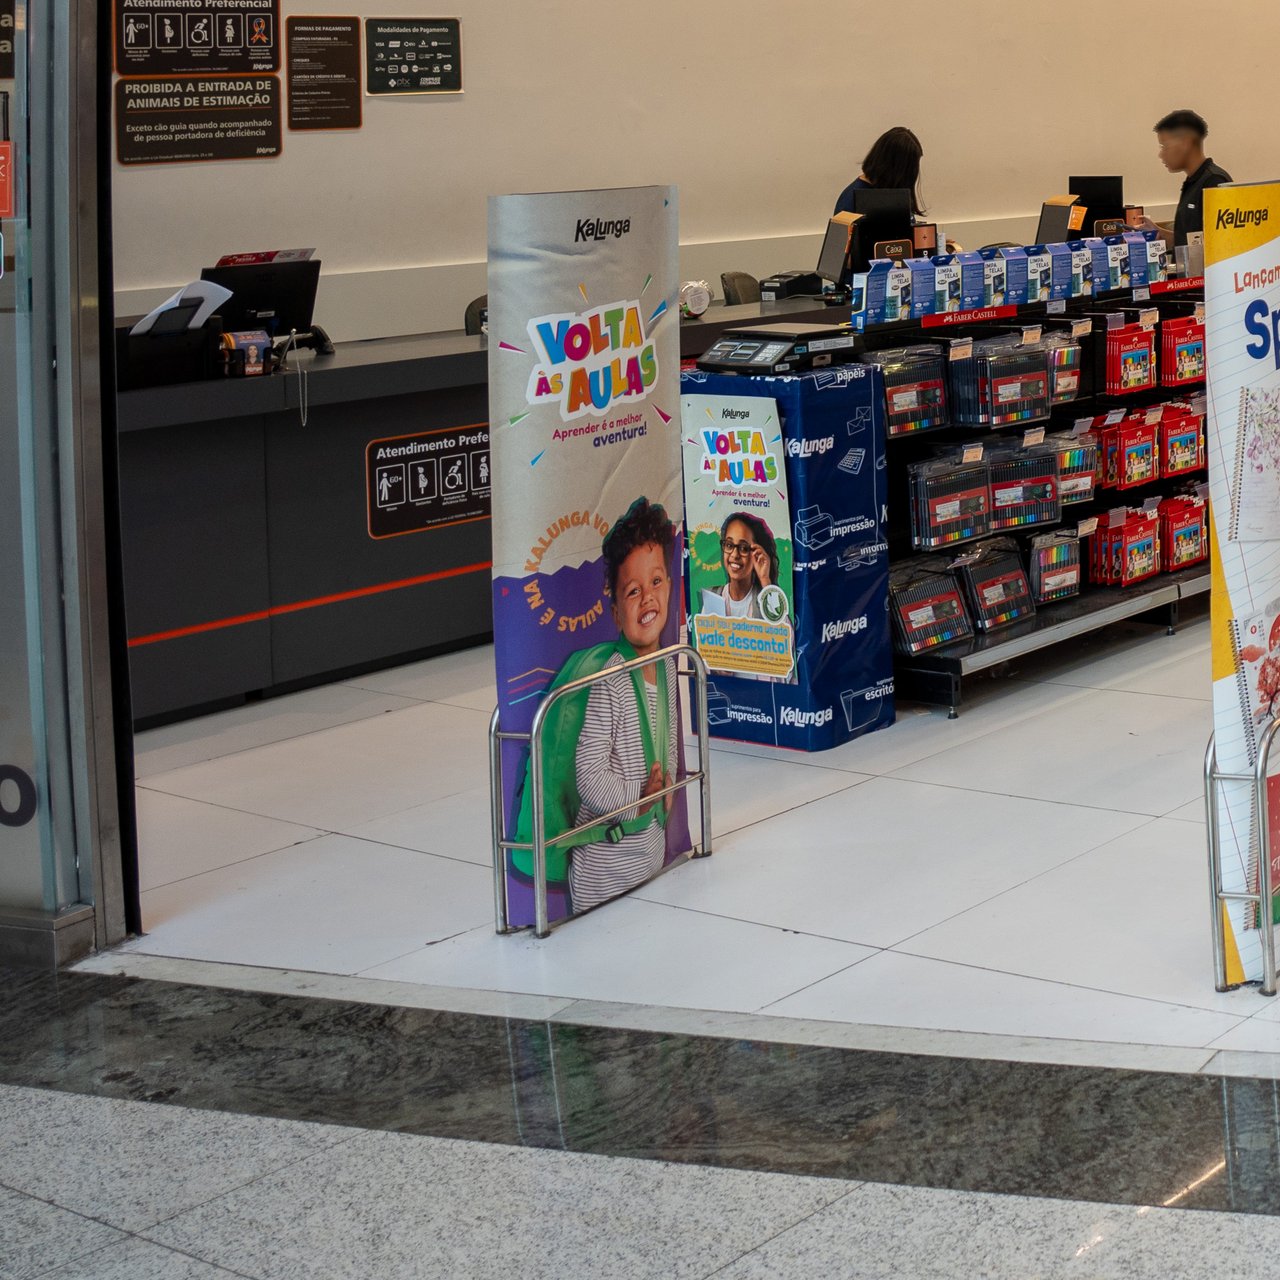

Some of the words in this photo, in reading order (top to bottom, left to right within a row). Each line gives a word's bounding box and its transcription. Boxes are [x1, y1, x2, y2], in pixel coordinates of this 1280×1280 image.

[125, 84, 182, 94] PROIBIDA
[198, 82, 253, 92] ENTRADA
[256, 81, 271, 90] DE
[127, 98, 180, 108] ANIMAIS
[184, 97, 199, 106] DE
[203, 93, 270, 106] ESTIMAÇÃO
[886, 245, 902, 254] Caixa
[536, 307, 643, 365] VOLTA
[567, 345, 654, 413] AULAS
[553, 425, 599, 441] Aprender
[617, 413, 642, 427] melhor
[593, 424, 647, 447] aventura!
[377, 438, 456, 459] Atendimento
[703, 430, 766, 455] VOLTA
[727, 708, 772, 724] impressão
